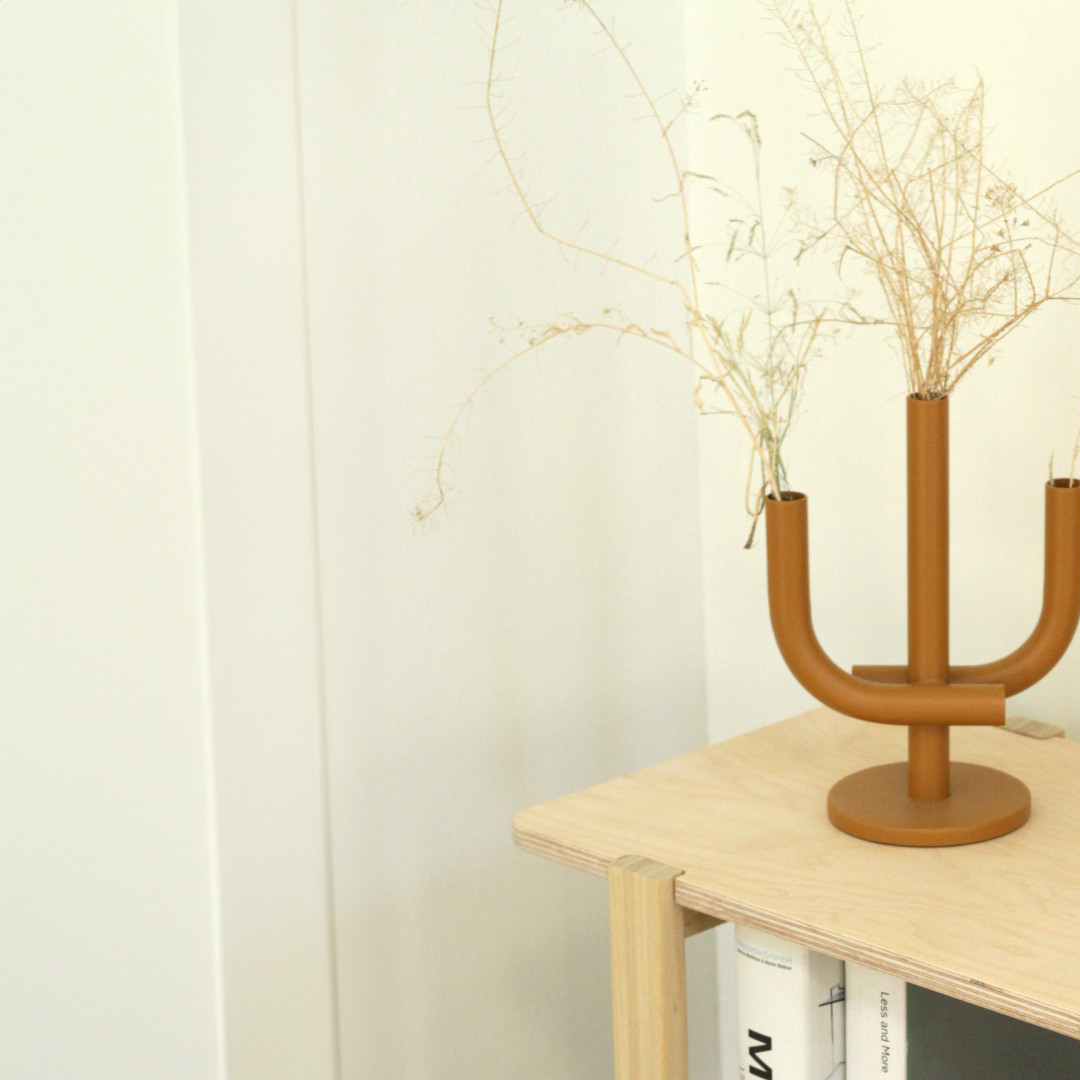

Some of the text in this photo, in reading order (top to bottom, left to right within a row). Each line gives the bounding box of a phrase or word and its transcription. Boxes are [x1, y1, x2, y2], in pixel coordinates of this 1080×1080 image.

[881, 991, 890, 1073] Less and More
